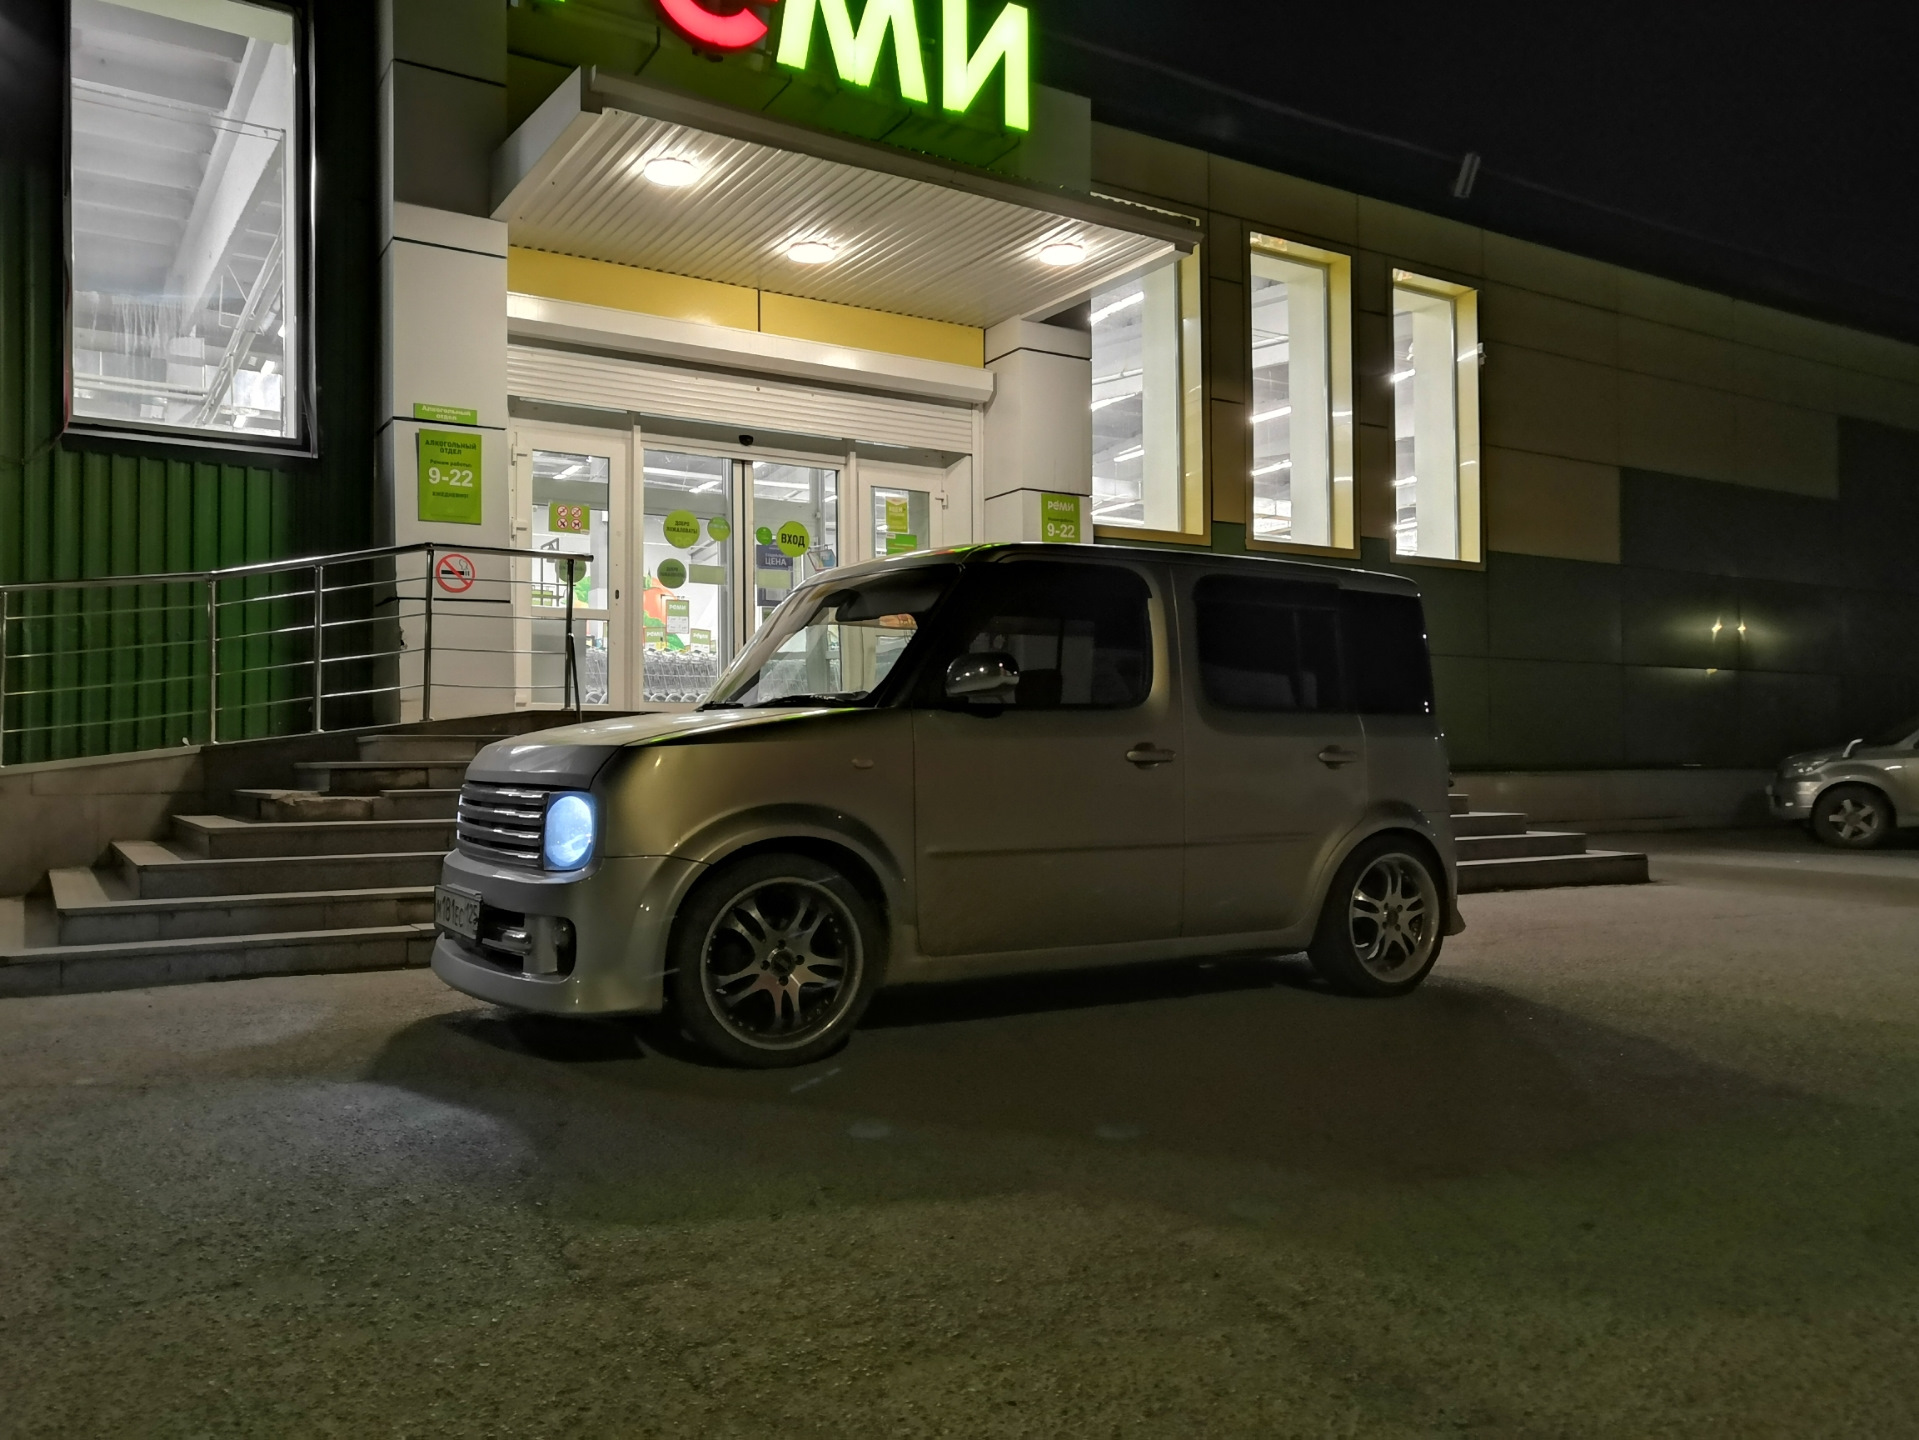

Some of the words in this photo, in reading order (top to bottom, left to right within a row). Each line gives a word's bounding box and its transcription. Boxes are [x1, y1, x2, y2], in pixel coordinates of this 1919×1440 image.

[425, 440, 476, 450] АЛКОГОЛЬНЫЙ
[440, 447, 461, 455] ОТДЕЛ
[429, 467, 473, 487] 9-22
[1047, 523, 1075, 538] 9-22
[781, 533, 806, 548] ВХОД
[765, 558, 787, 566] ЦЕНА
